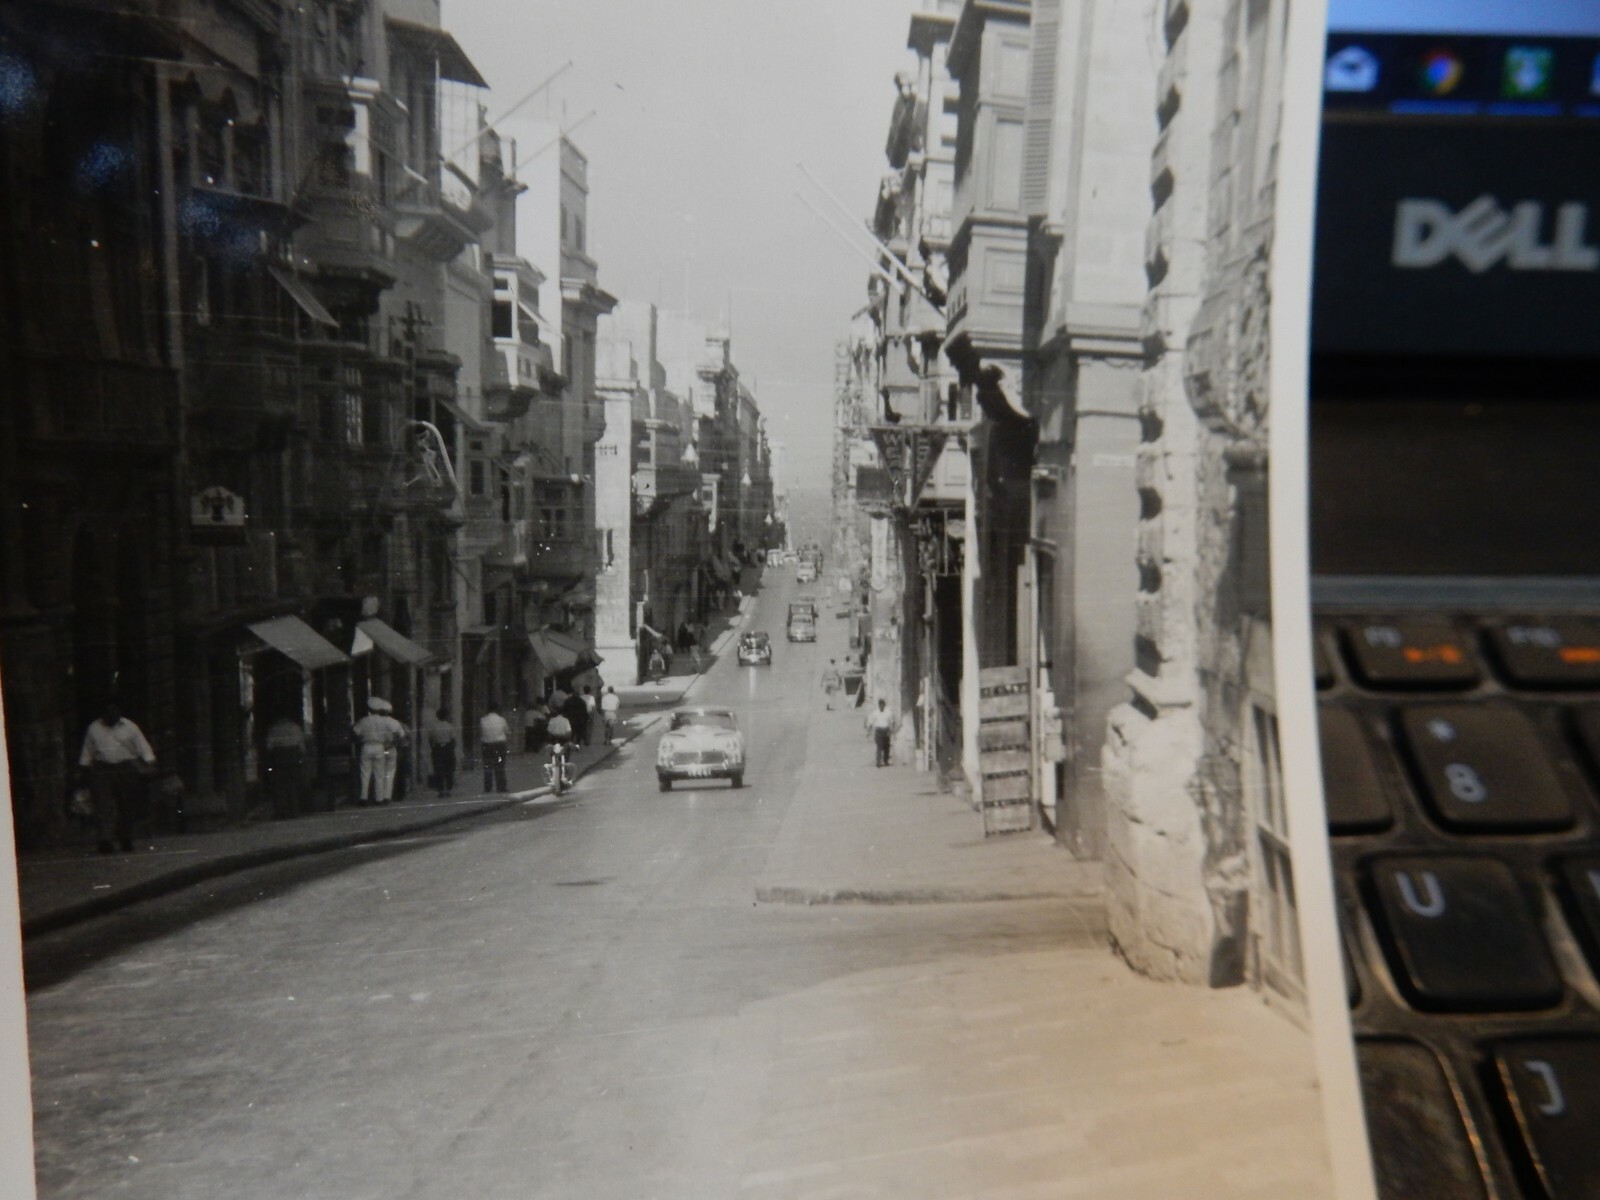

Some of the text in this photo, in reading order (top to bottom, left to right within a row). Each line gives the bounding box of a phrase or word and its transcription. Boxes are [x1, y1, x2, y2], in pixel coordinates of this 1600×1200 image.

[1392, 194, 1600, 274] DELL
[1445, 763, 1487, 803] 8
[1395, 871, 1445, 917] U
[1525, 1060, 1565, 1115] J
